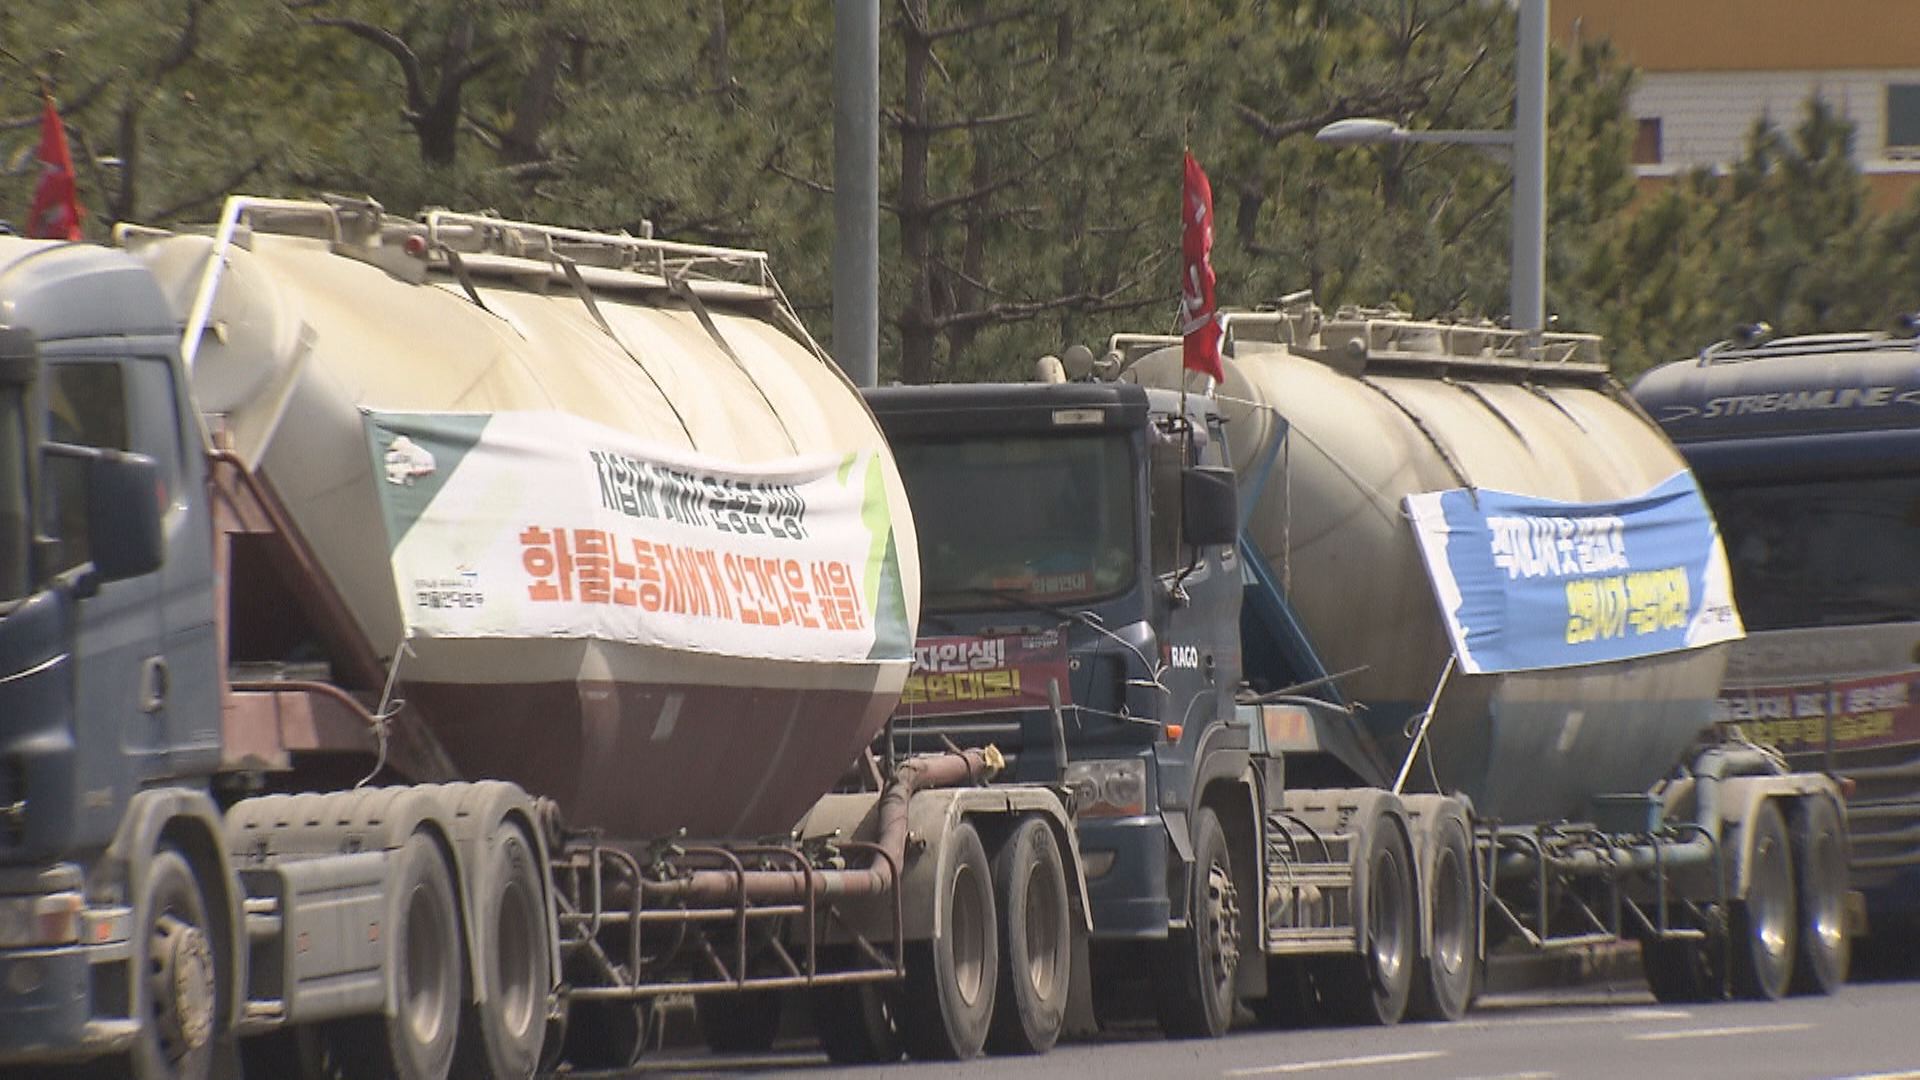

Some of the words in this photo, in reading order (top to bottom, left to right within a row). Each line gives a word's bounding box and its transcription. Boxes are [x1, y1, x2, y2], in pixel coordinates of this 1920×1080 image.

[1702, 386, 1897, 418] STREAMLINE
[520, 526, 733, 620] 화물노동자에게
[725, 553, 821, 629] 인간다운
[809, 561, 866, 631] 삶을!
